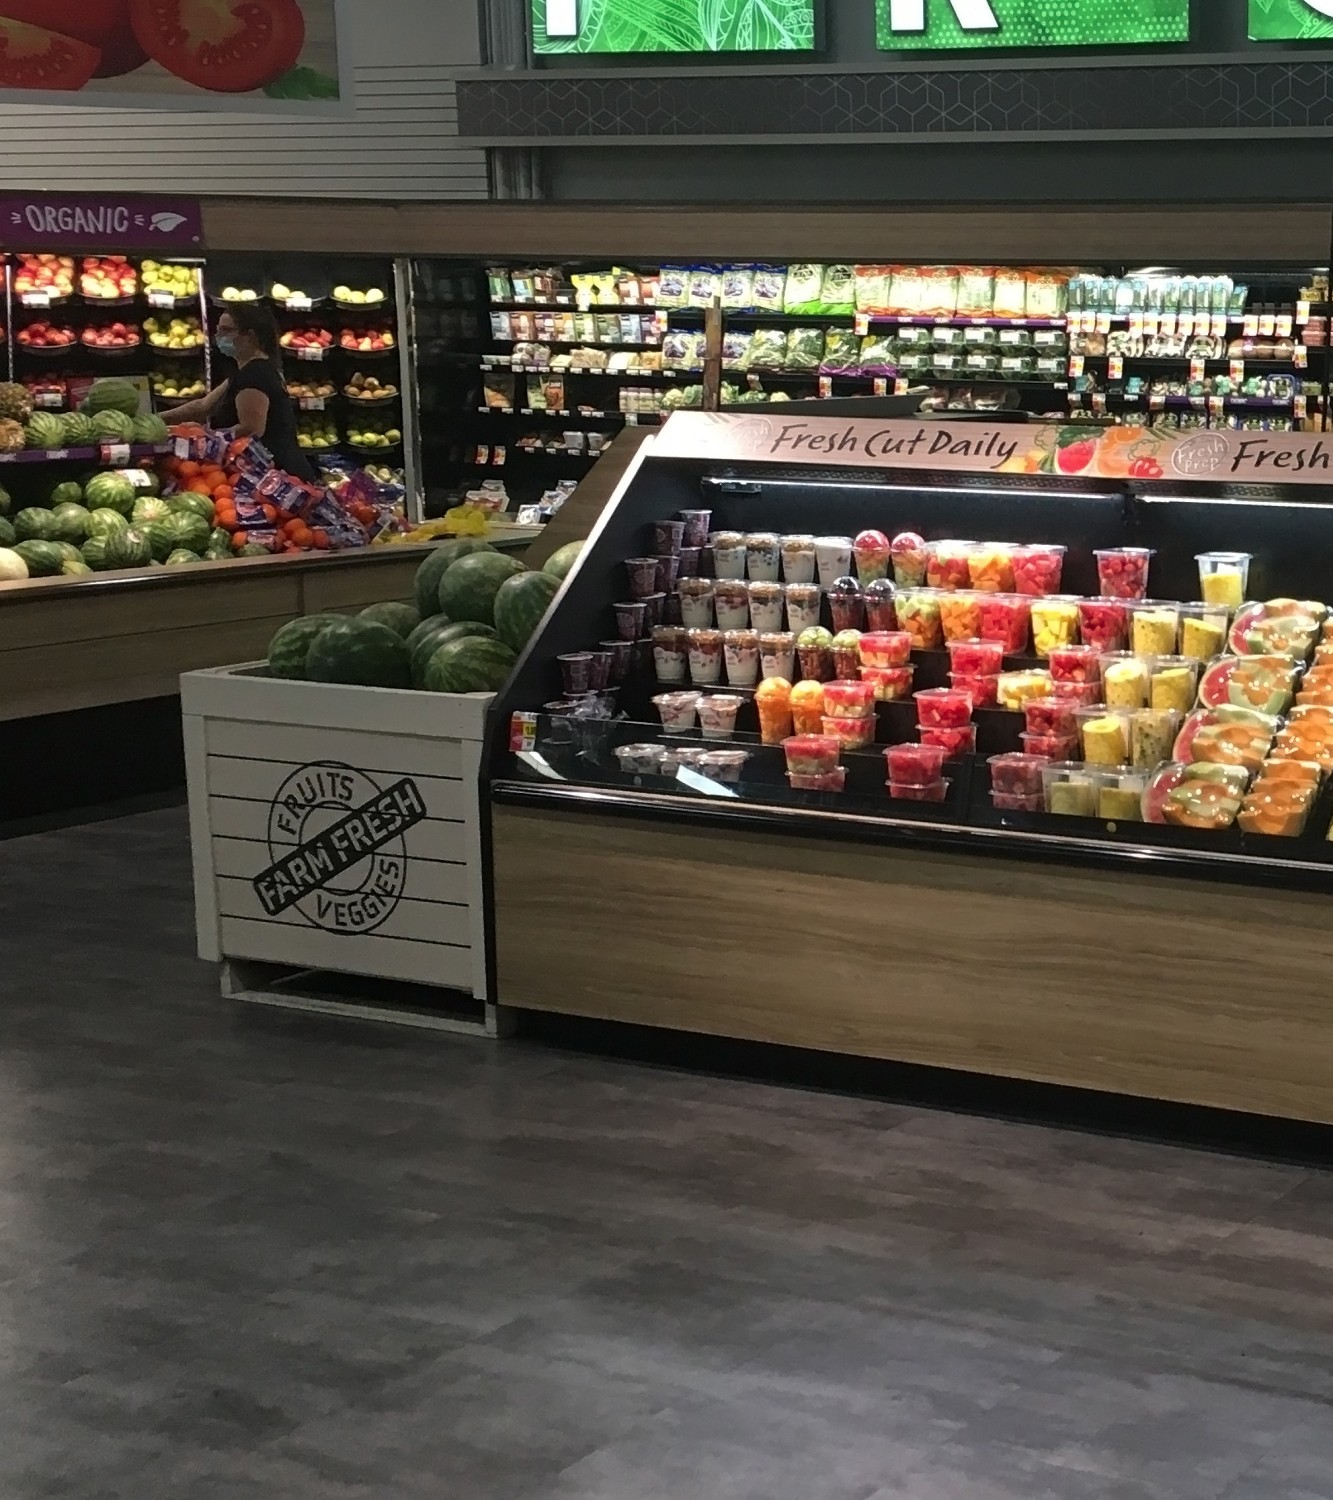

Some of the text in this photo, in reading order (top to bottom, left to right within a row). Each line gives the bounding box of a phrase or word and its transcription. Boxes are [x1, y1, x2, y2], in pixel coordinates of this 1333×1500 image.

[25, 205, 129, 234] ORGANIC
[770, 423, 857, 455] Fresh
[864, 429, 927, 459] Cut
[927, 431, 1018, 470] Daily
[1178, 438, 1224, 464] Fresh
[1231, 439, 1329, 473] Fresh
[277, 772, 354, 835] FRUITS
[258, 784, 422, 911] FARM FRESH
[317, 859, 399, 926] VEGGIES
